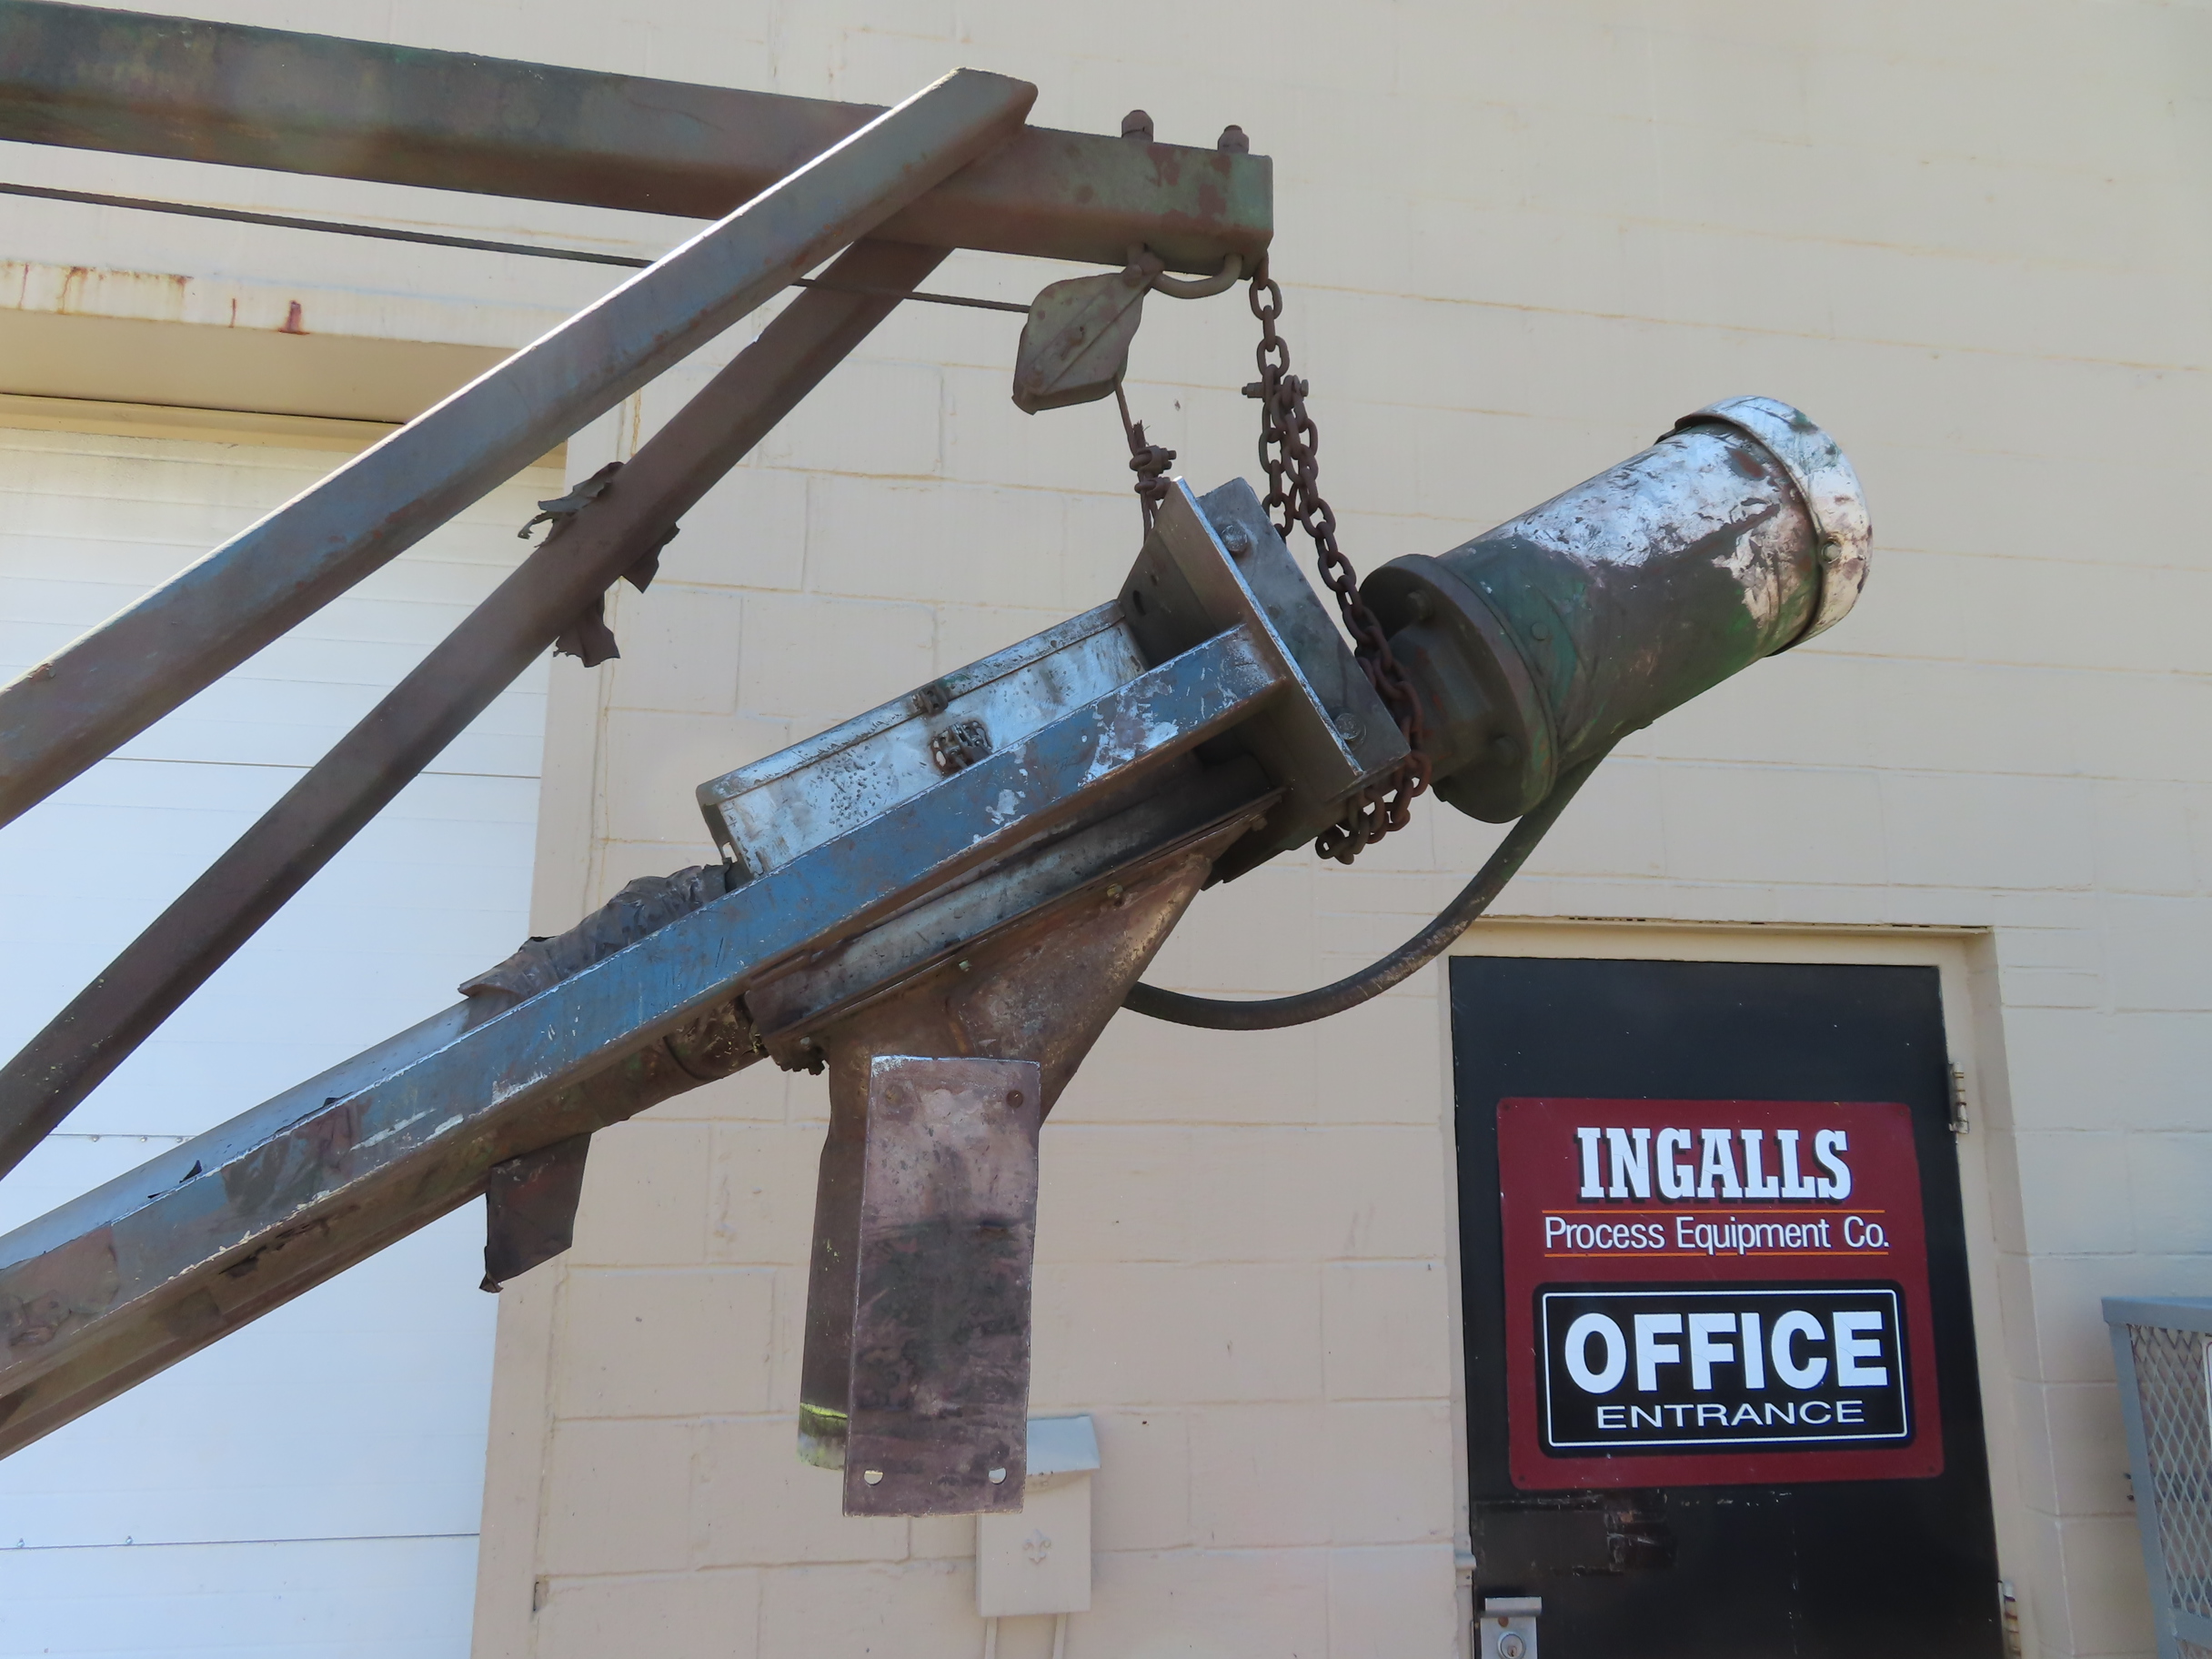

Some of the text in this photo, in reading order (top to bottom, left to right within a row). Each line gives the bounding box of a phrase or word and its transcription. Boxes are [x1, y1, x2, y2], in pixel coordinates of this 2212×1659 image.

[1576, 1126, 1853, 1201] INGALLS
[1544, 1215, 1890, 1255] Process Equipment Co.
[1564, 1310, 1888, 1394] OFFICE
[1596, 1400, 1865, 1430] ENTRANCE
